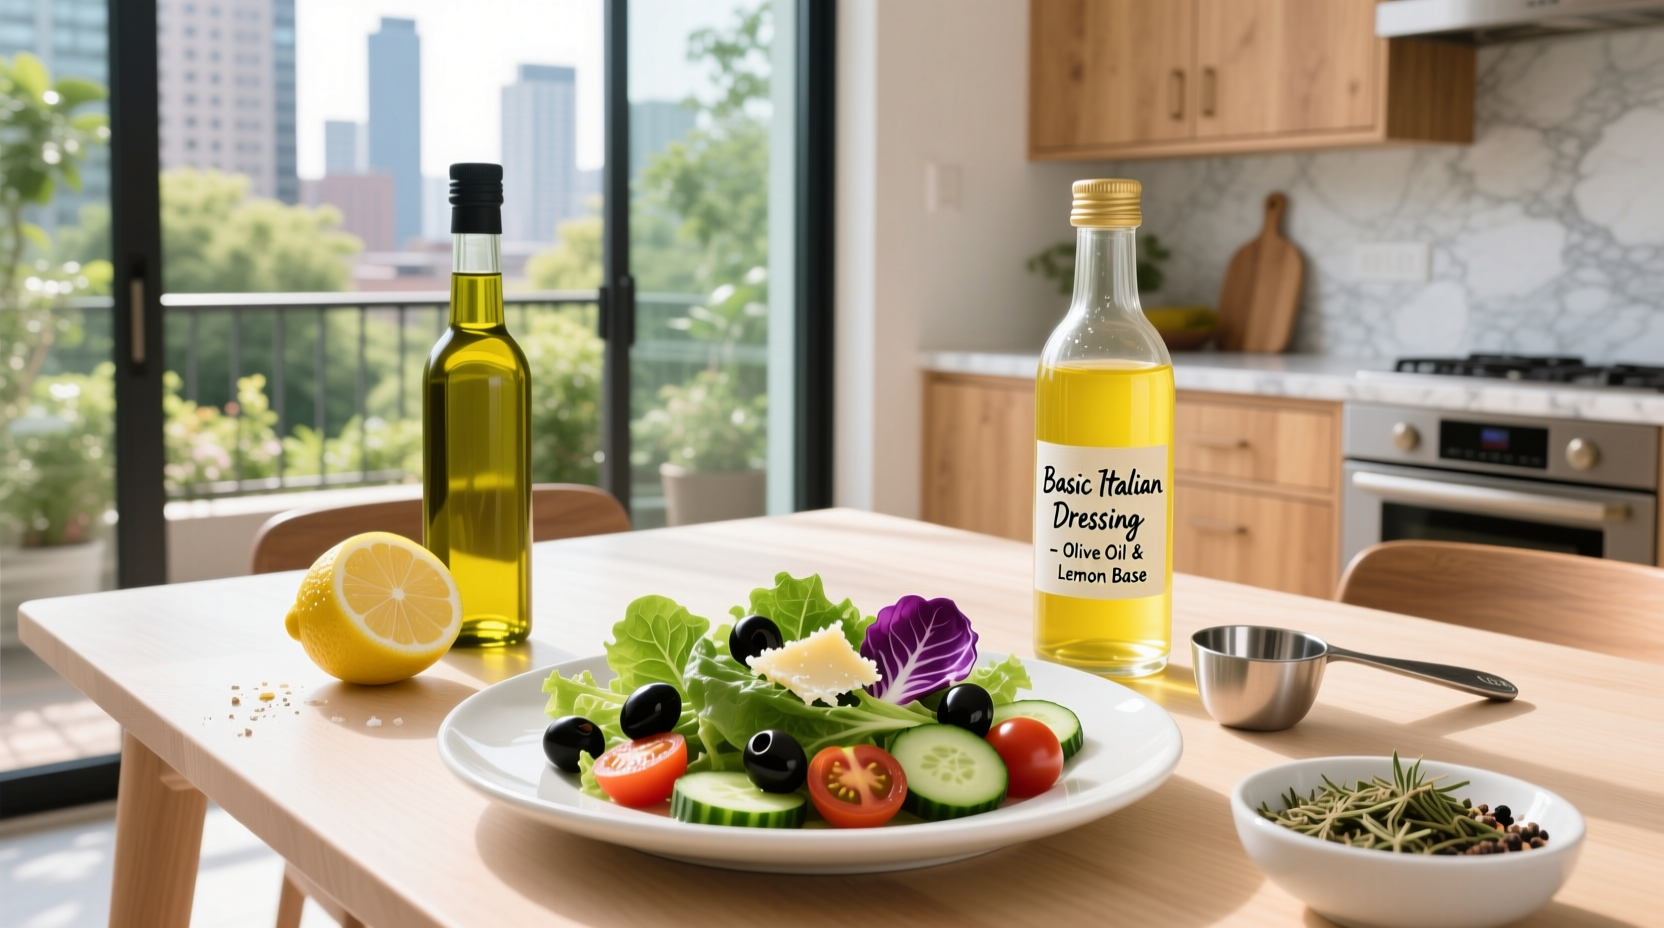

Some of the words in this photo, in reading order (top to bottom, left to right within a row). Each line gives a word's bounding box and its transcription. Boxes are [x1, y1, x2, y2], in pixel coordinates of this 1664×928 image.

[1043, 465, 1093, 496] Basic
[1097, 468, 1164, 498] Italian
[1053, 500, 1146, 543] Dressing
[1062, 541, 1101, 560] Olive
[1104, 543, 1127, 561] Oil
[1131, 543, 1144, 560] &
[1058, 563, 1107, 584] Lemon
[1111, 567, 1148, 584] Base
